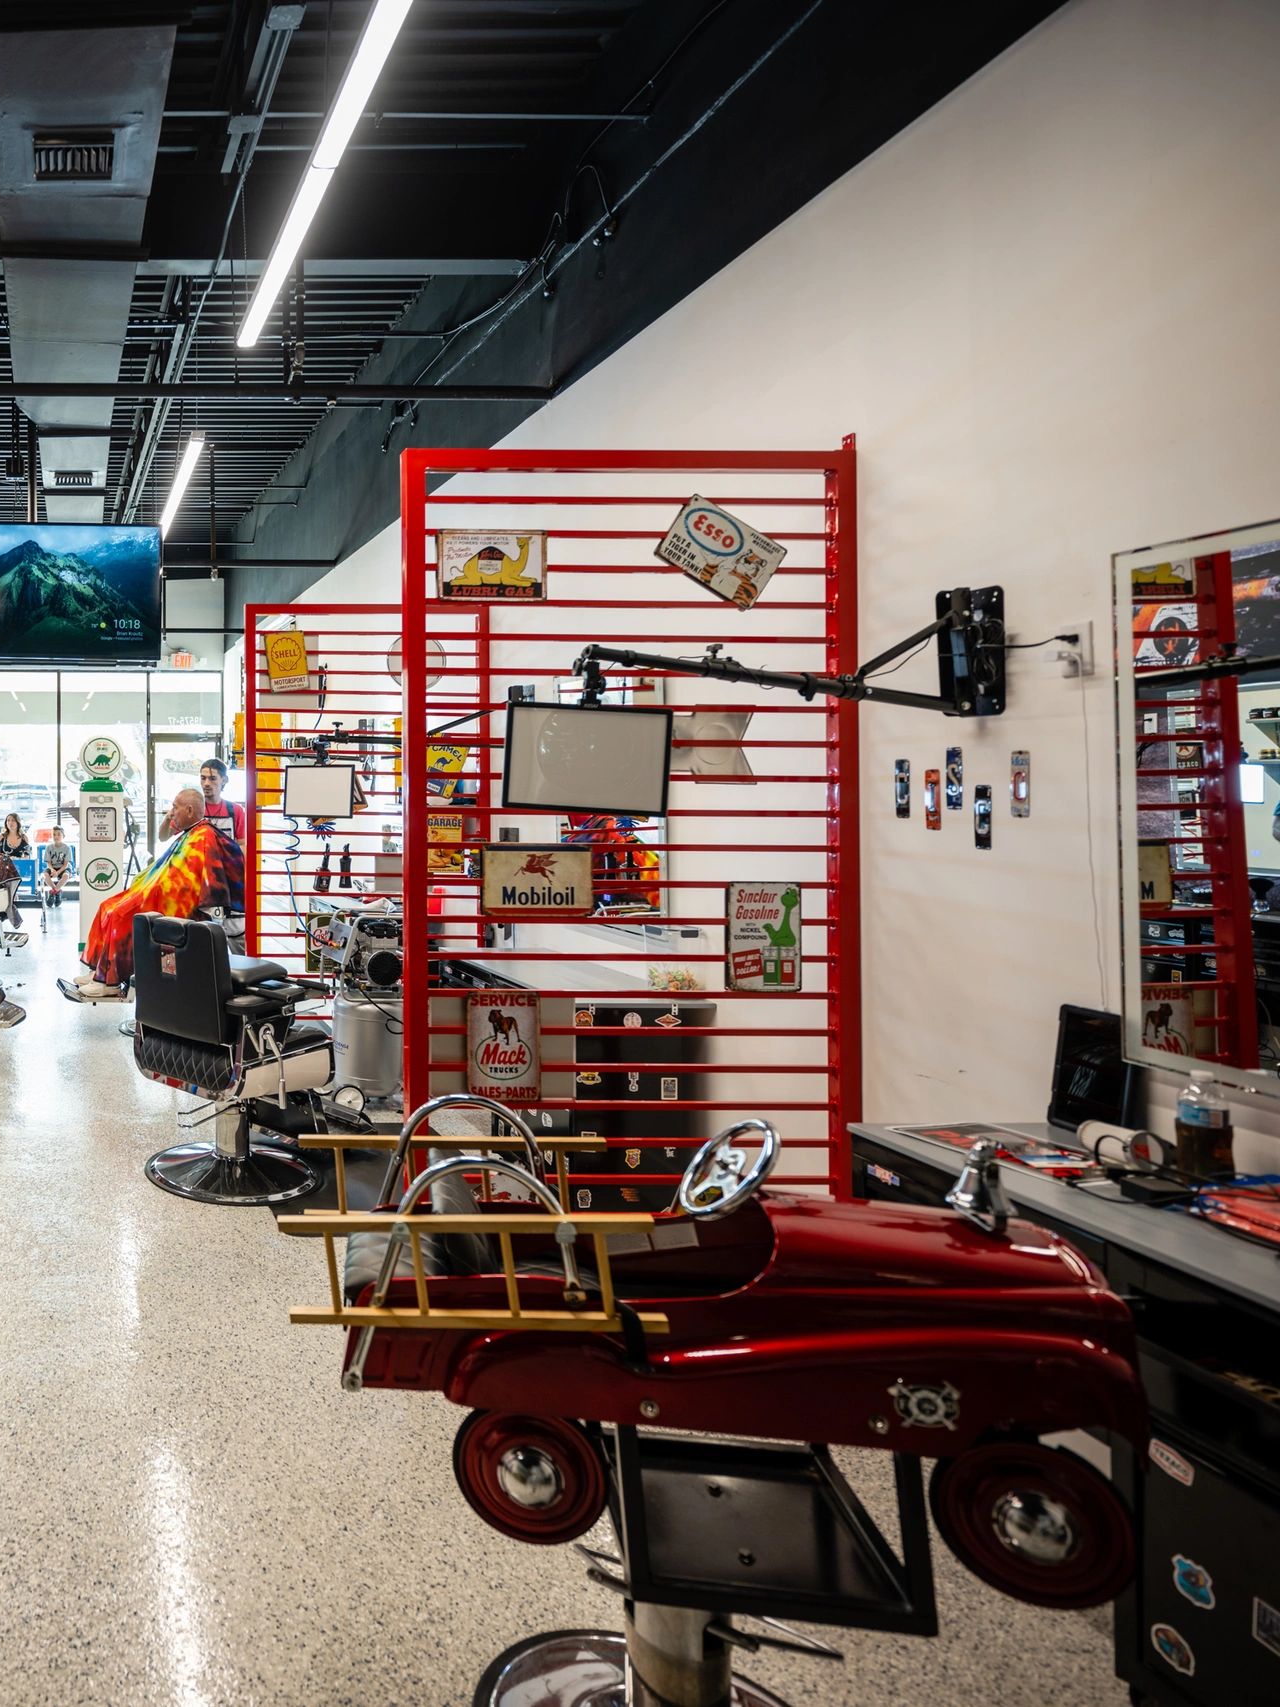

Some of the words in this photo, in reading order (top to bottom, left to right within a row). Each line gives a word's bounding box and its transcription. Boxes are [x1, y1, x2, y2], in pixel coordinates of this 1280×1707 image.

[672, 533, 686, 545] PUT
[664, 547, 683, 564] YOUR
[668, 538, 689, 557] TIGER
[687, 551, 697, 561] IN
[113, 619, 141, 630] 10:18
[275, 649, 298, 659] SHELL
[174, 654, 193, 668] EXIT
[273, 676, 306, 686] MOTORSPORT
[431, 745, 463, 762] CAMEL
[428, 818, 462, 828] GARAGE
[502, 886, 575, 906] Mobiloil
[737, 888, 778, 904] Sinclair
[735, 905, 780, 920] Gasoline
[470, 994, 537, 1007] SERVICE
[480, 1043, 528, 1065] Mack
[489, 1066, 519, 1074] TRUCKS
[471, 1086, 537, 1099] SALES-PARTS
